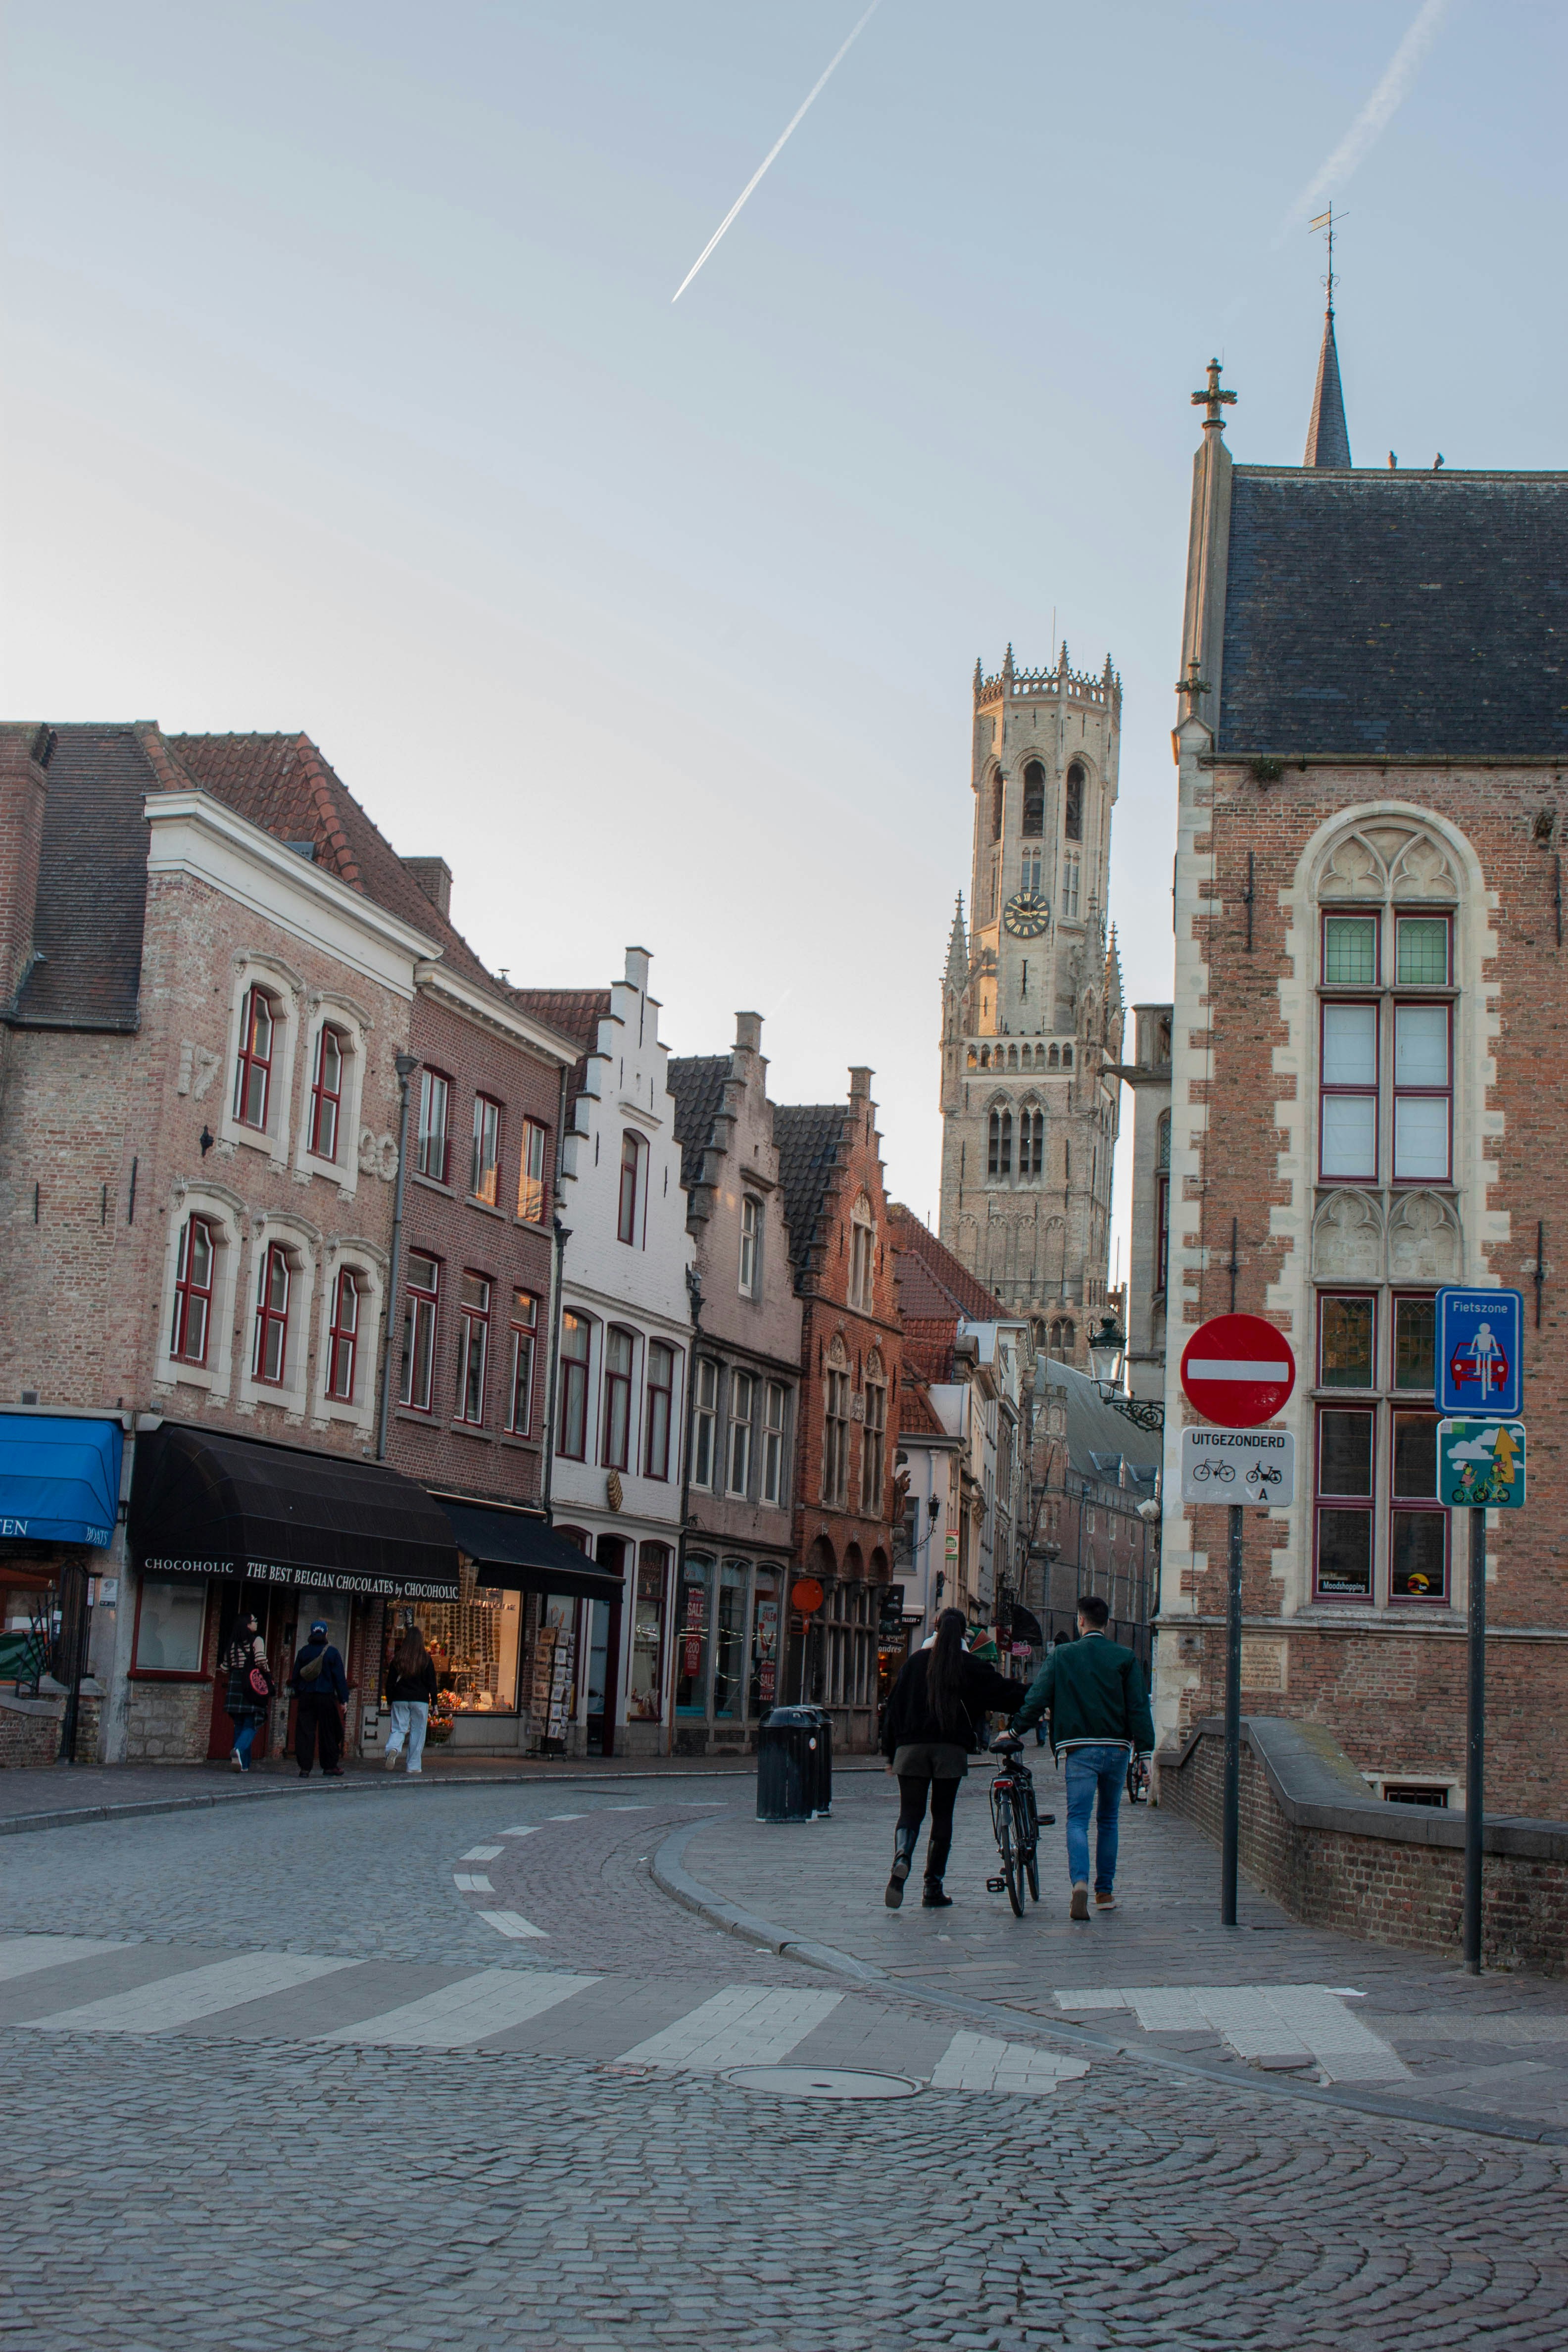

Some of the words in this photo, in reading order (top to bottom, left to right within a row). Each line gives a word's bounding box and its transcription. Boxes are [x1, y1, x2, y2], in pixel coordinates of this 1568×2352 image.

[1453, 1301, 1508, 1314] Fietszone
[1192, 1433, 1285, 1448] UITGEZONDERD
[1258, 1488, 1268, 1500] A
[85, 1526, 108, 1545] BOATS
[145, 1558, 234, 1573] CHOCOHOLIC
[246, 1562, 268, 1579] THE
[269, 1566, 293, 1582] BEST
[294, 1569, 335, 1588] BELGIAN
[336, 1574, 393, 1594] CHOCOLATES
[395, 1583, 403, 1597] by
[404, 1582, 459, 1599] CHOCOHOLIC
[1323, 1581, 1365, 1593] Moodshopping
[687, 1602, 704, 1617] SALE
[760, 1673, 775, 1687] SALE
